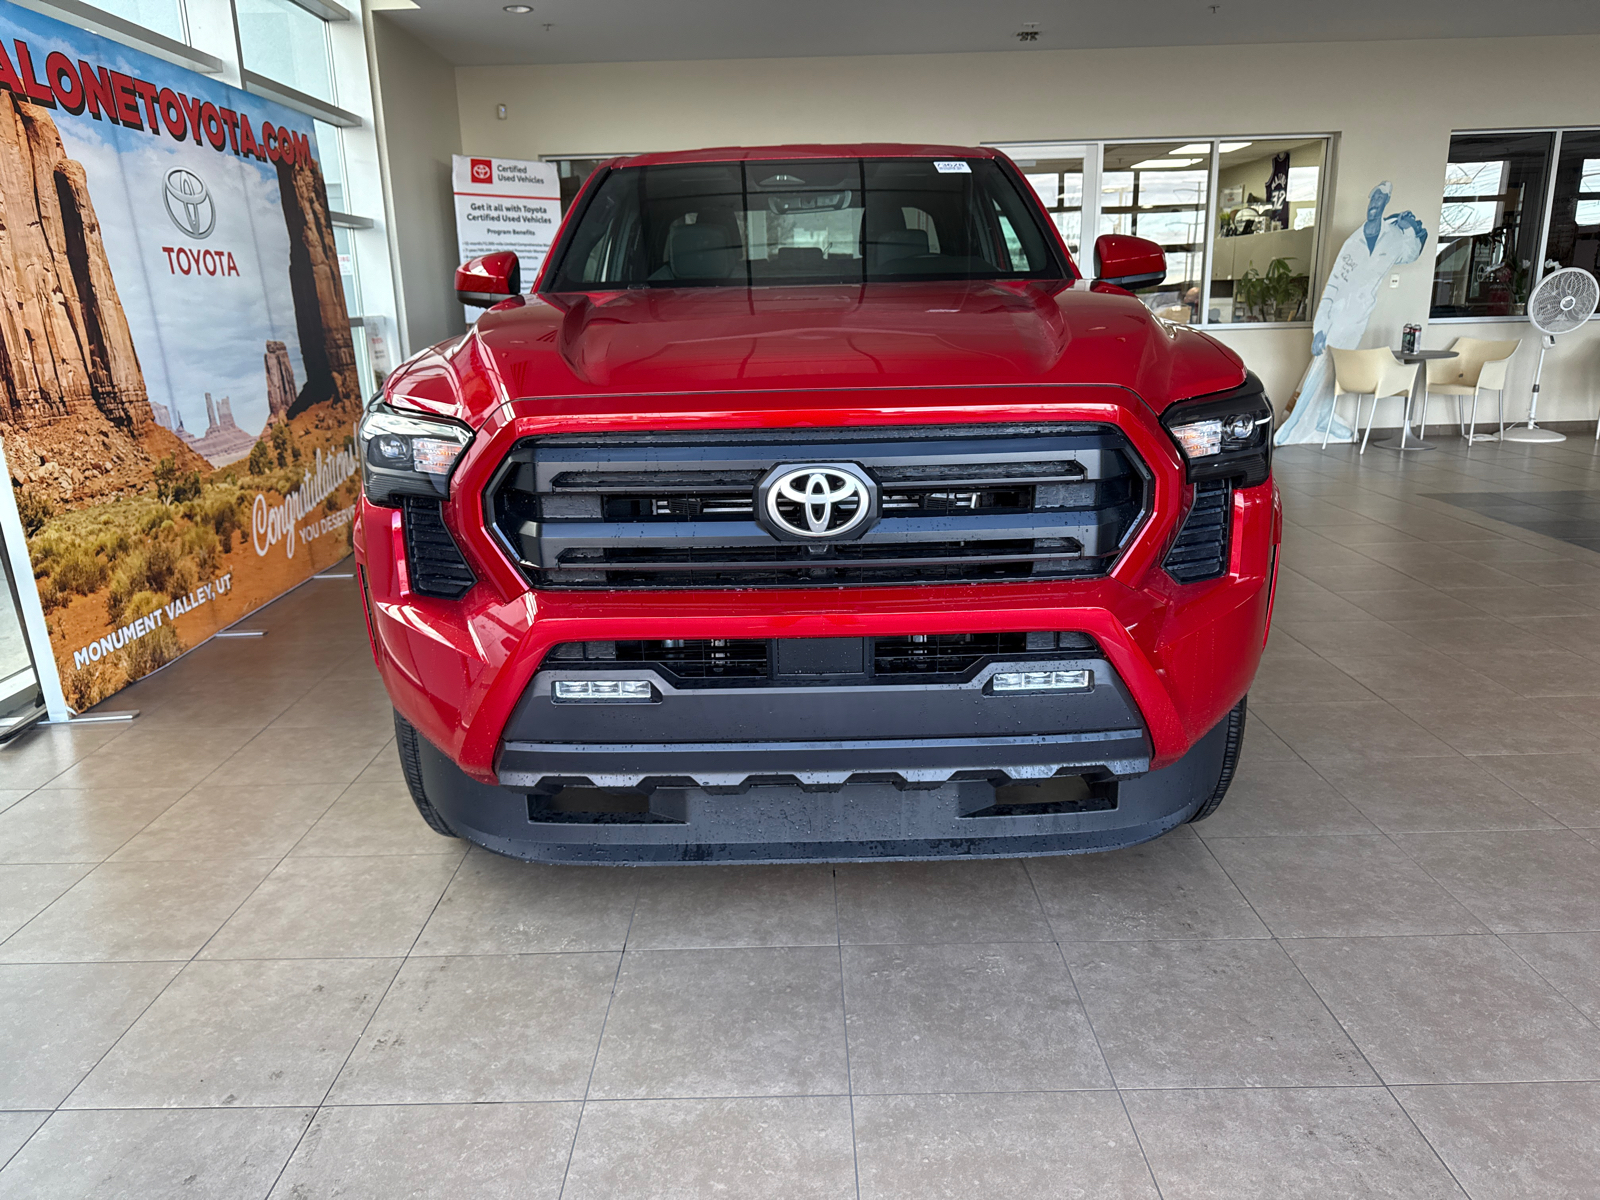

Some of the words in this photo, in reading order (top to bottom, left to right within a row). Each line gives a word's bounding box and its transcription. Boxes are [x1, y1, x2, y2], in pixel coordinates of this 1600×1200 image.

[497, 164, 527, 174] Certified
[498, 174, 516, 182] Used
[516, 175, 545, 184] Vehicles
[470, 203, 485, 211] Get
[486, 203, 493, 211] it
[494, 204, 503, 212] all
[505, 204, 522, 213] with
[522, 205, 547, 214] Toyota
[467, 213, 500, 222] Certified
[502, 214, 520, 223] Used
[522, 215, 552, 224] Vehicles
[487, 228, 511, 236] Program
[512, 228, 535, 236] Benefits
[162, 246, 240, 277] TOYOTA
[252, 421, 360, 559] Congratulations!
[299, 521, 320, 544] YOU
[73, 608, 163, 671] MONUMENT
[164, 583, 217, 622] VALLEY,
[215, 573, 232, 595] UT
